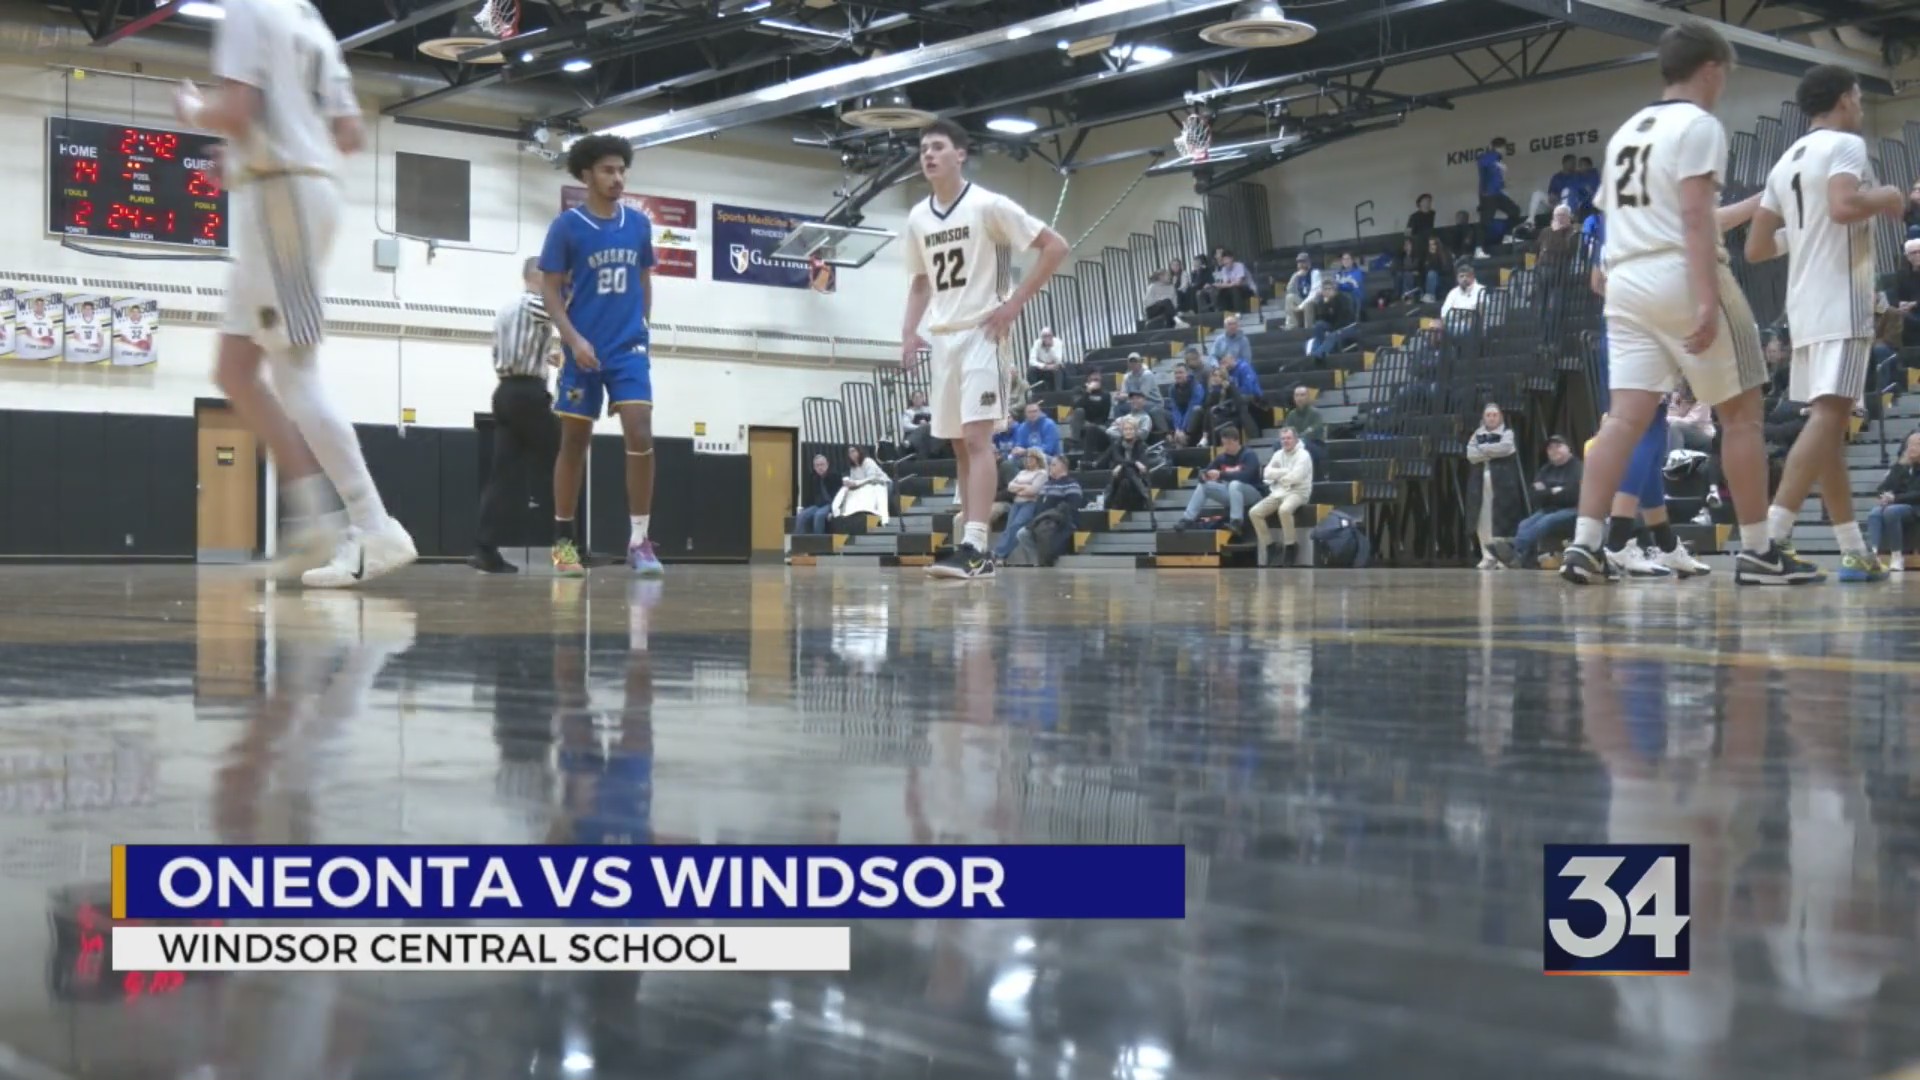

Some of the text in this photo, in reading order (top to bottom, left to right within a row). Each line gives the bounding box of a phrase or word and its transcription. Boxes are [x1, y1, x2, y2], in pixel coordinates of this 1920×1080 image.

[59, 143, 99, 159] HOME
[120, 129, 177, 159] 2:42
[1447, 129, 1599, 166] KNIS GUESTS
[183, 157, 218, 170] GUES
[1615, 144, 1653, 208] 21
[1791, 172, 1803, 229] 1
[74, 201, 93, 226] 2
[203, 213, 222, 238] 2
[717, 210, 746, 223] Sports
[924, 226, 970, 248] WINDSOR
[588, 248, 638, 269] ONEONTA
[933, 247, 967, 292] 22
[597, 266, 627, 294] 20
